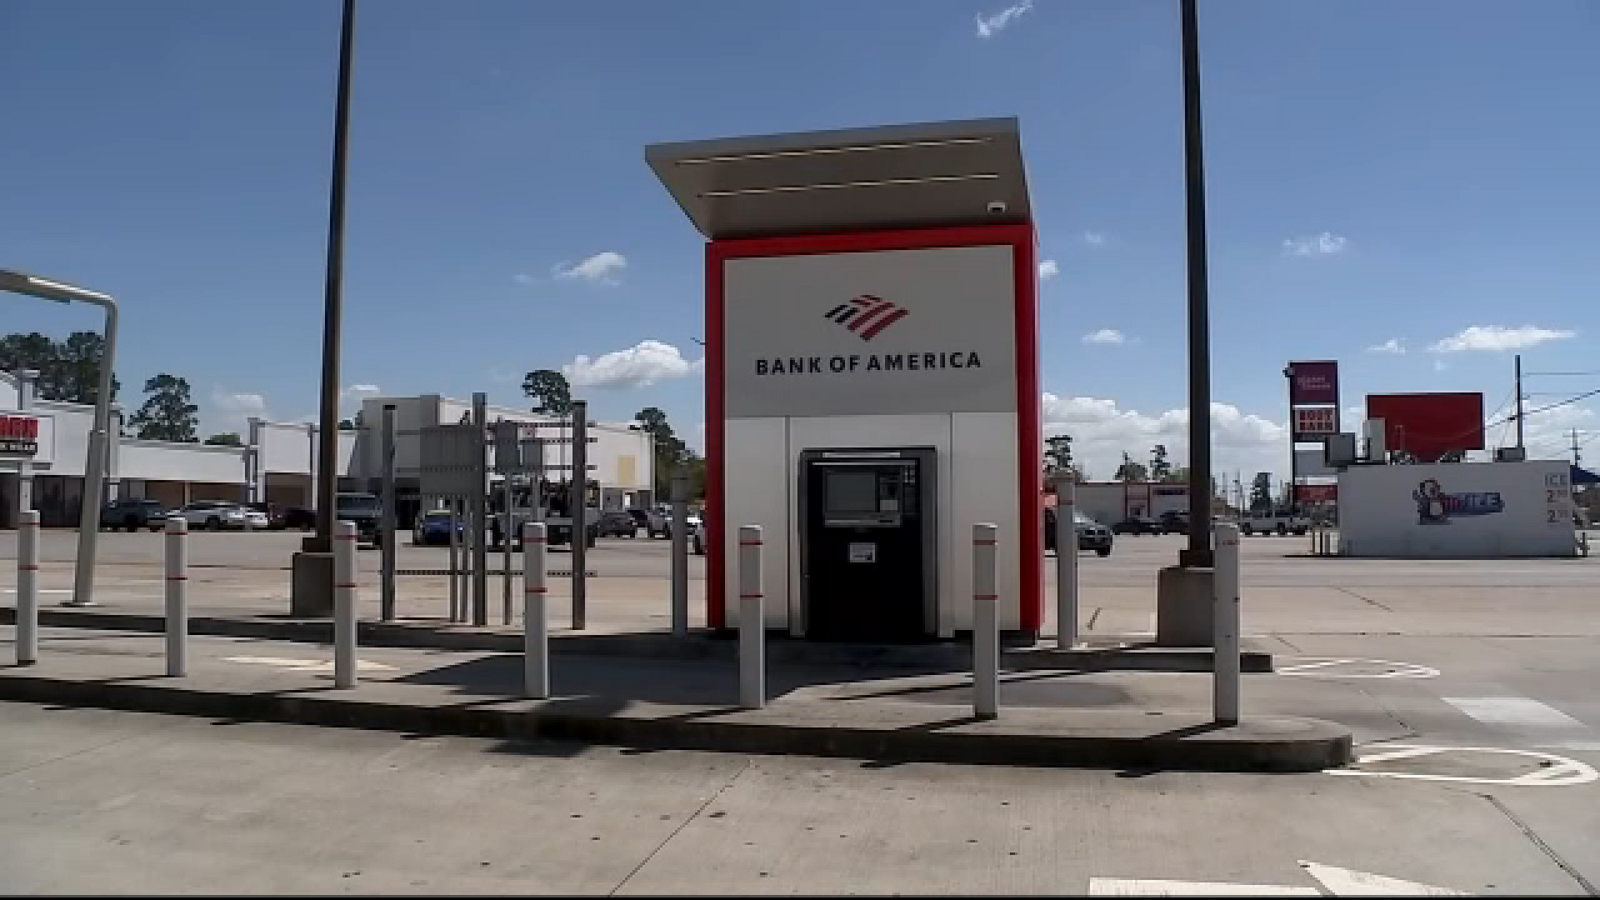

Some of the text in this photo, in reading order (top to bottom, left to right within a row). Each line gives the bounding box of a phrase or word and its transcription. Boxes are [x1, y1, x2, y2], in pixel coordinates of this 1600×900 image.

[755, 351, 982, 376] BANK OF AMERICA
[1544, 474, 1568, 486] ICE
